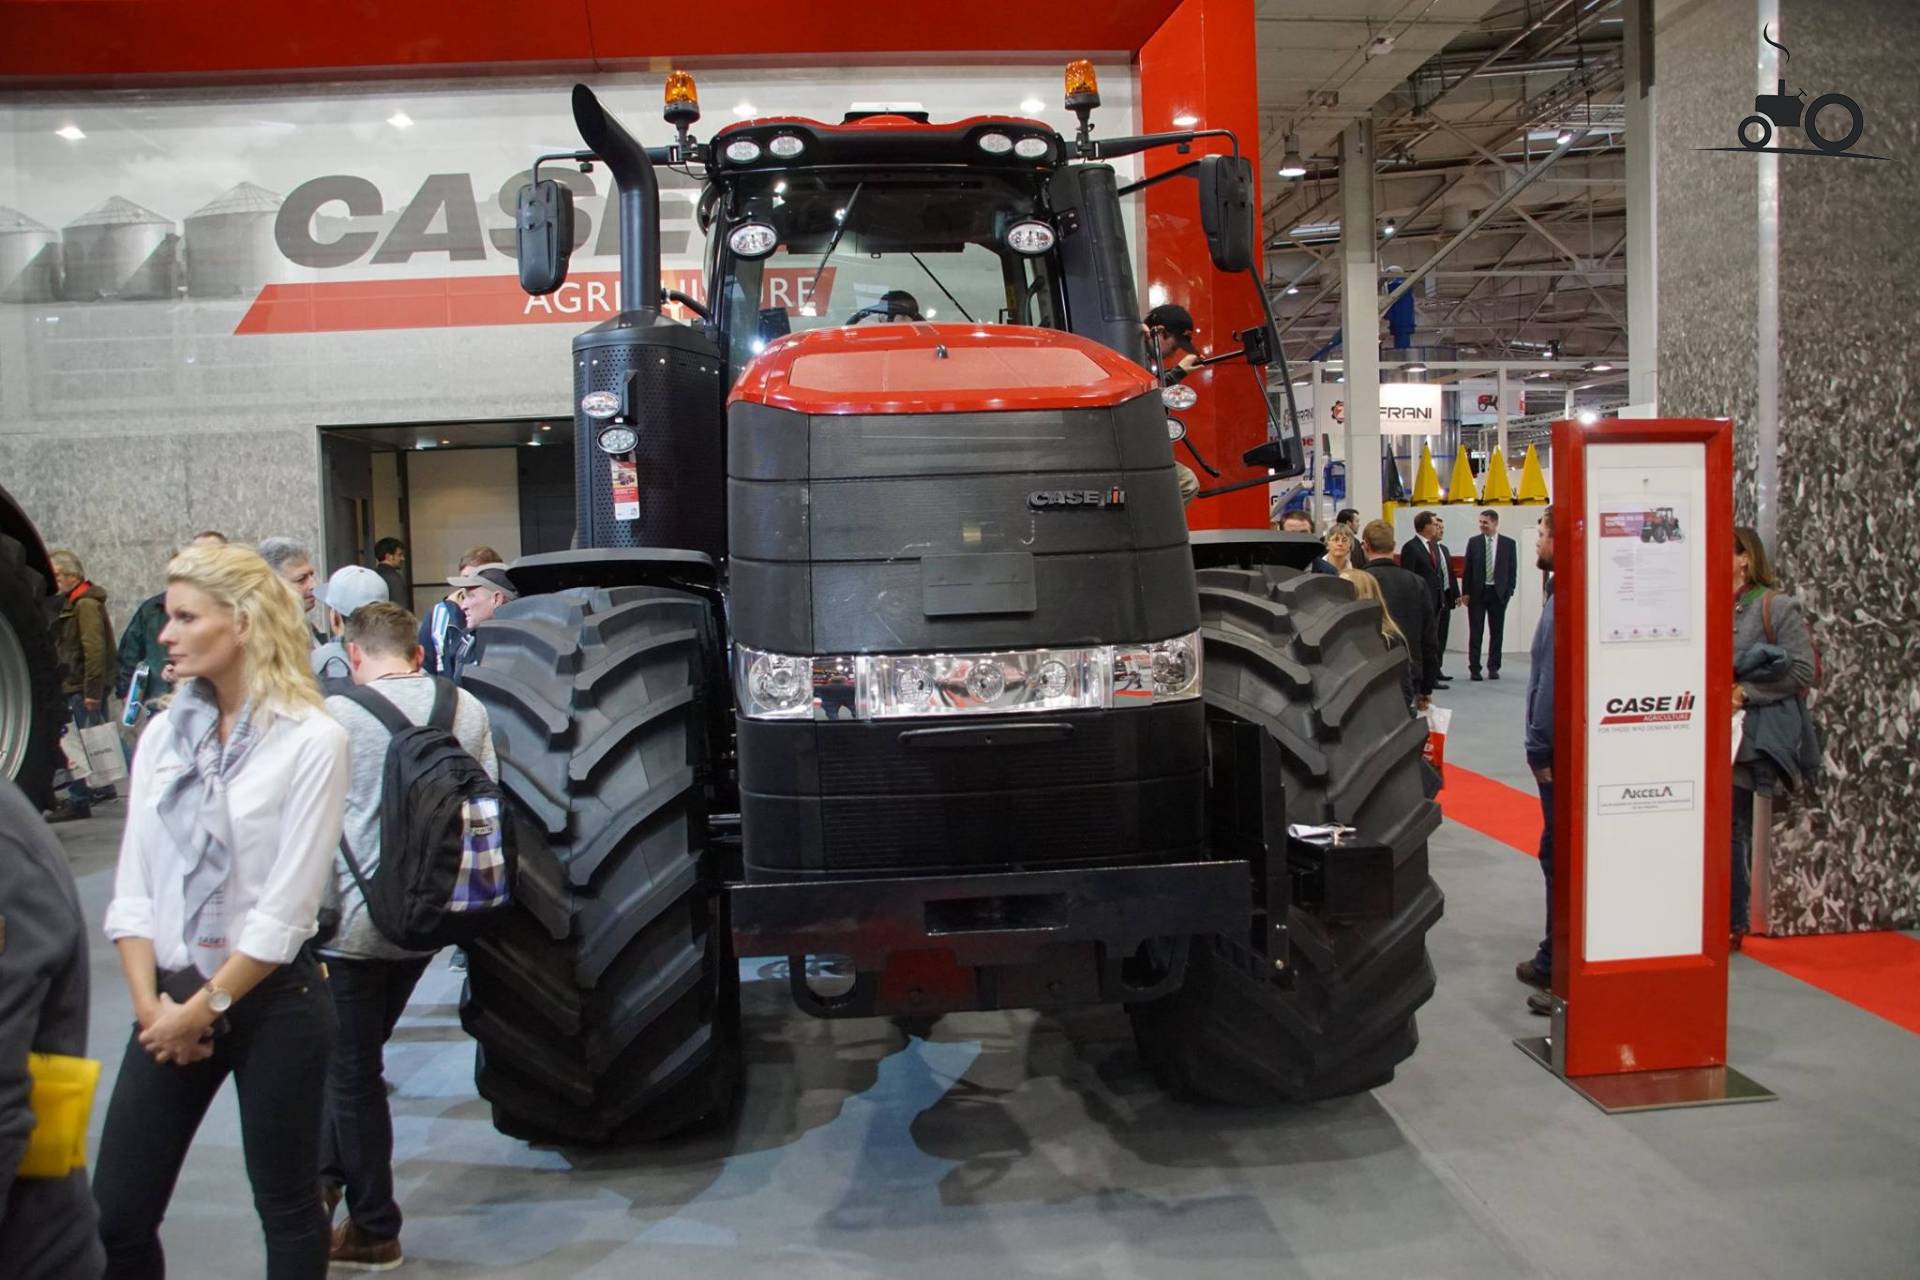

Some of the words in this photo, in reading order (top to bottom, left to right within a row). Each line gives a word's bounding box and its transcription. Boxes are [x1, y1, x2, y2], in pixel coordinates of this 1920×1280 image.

[274, 166, 701, 268] CASE
[1027, 490, 1100, 507] CASE
[1606, 696, 1672, 714] CASE
[1643, 713, 1690, 721] AGRICULTURE
